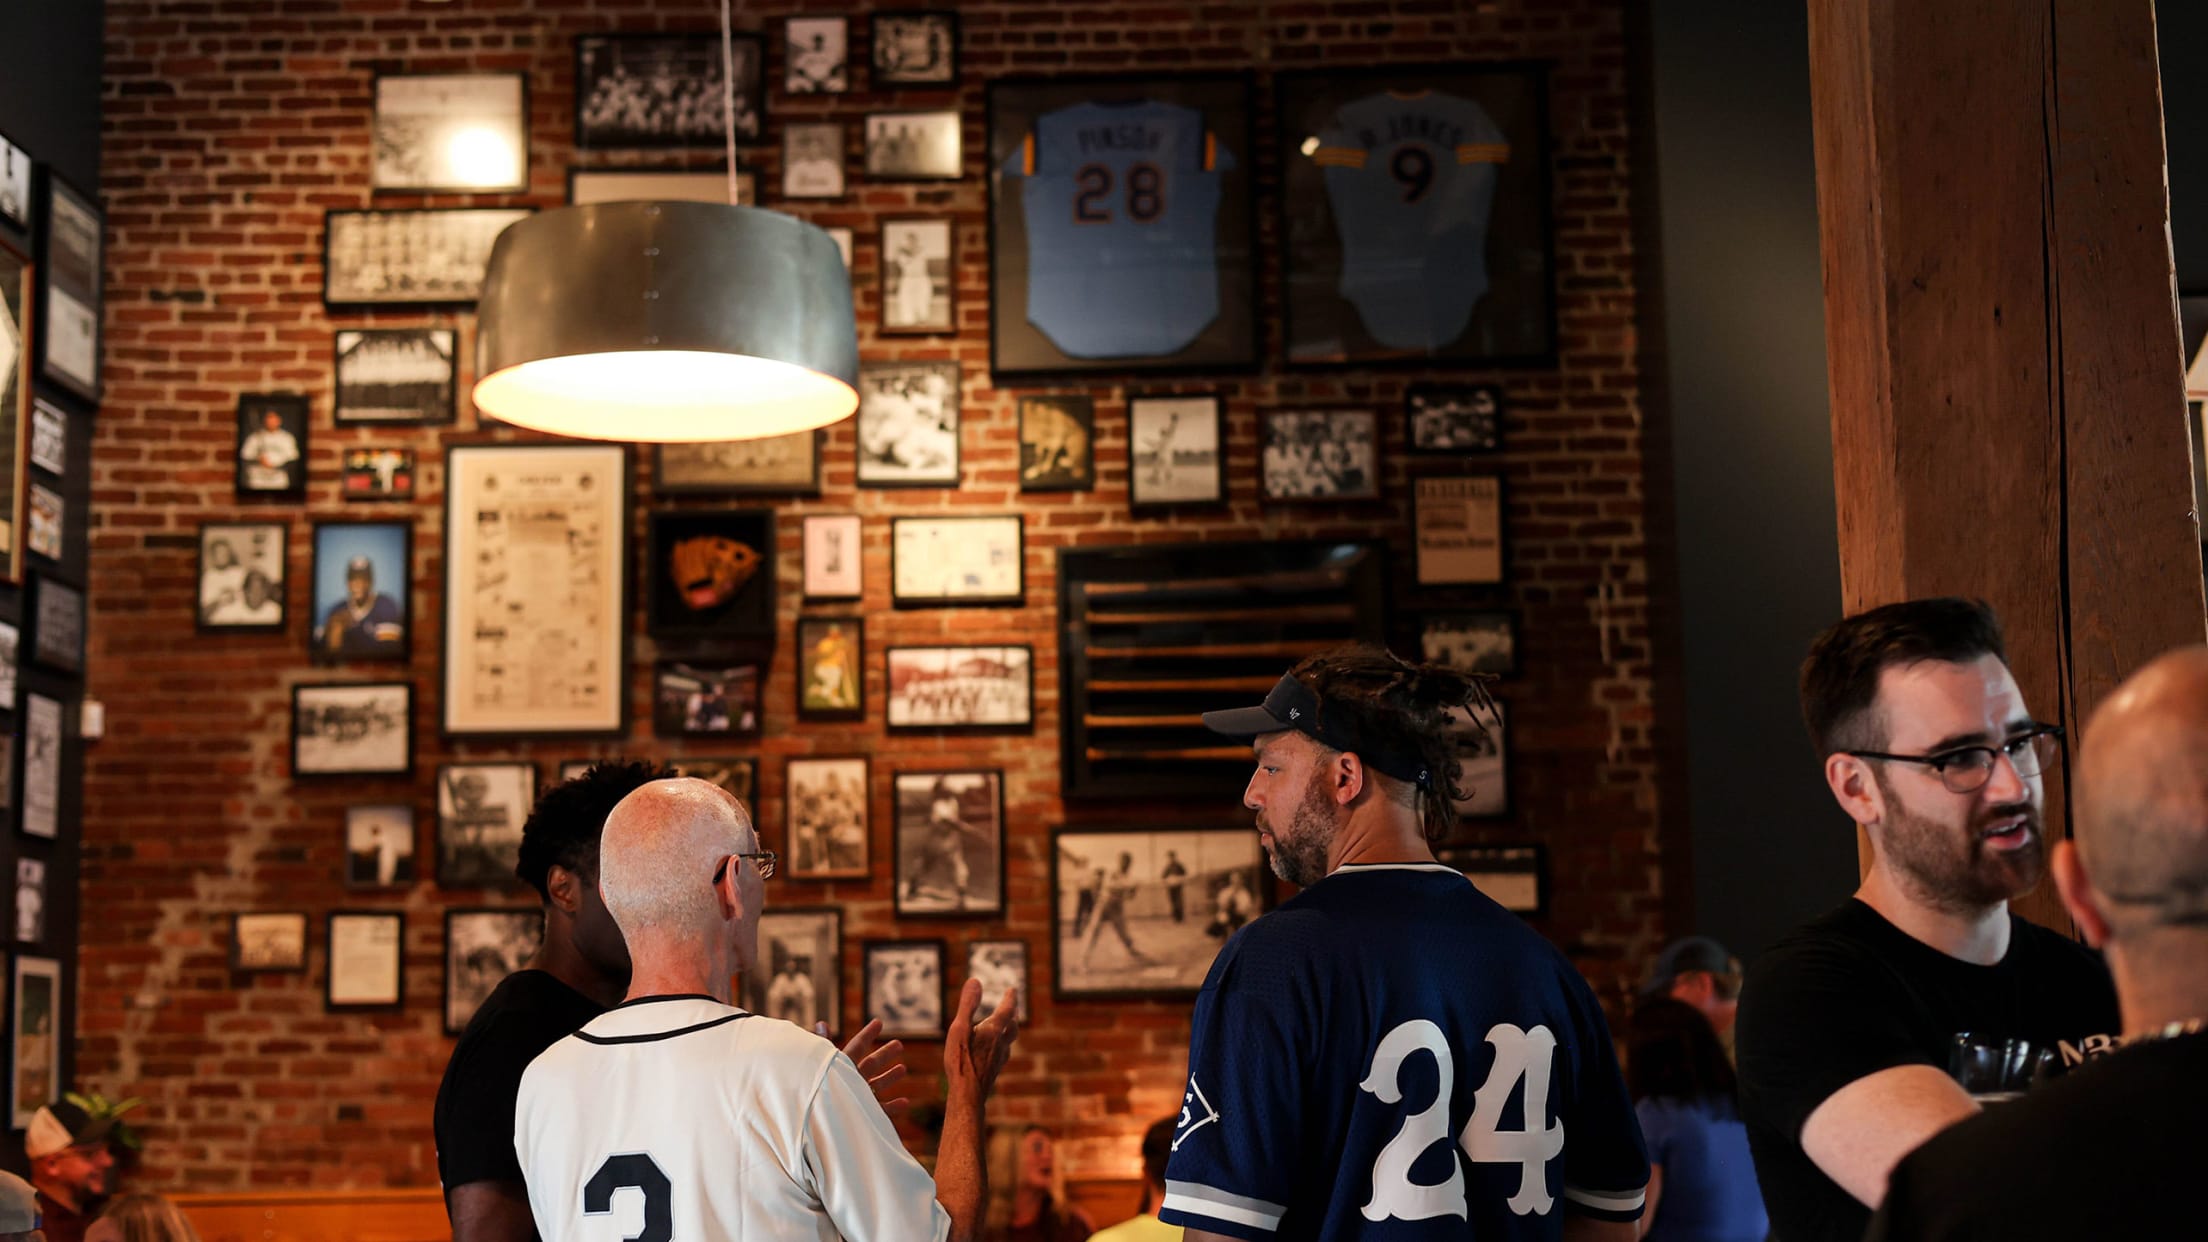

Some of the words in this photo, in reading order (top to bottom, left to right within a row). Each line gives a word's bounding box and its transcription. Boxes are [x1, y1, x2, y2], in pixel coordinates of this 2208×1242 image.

[1072, 161, 1168, 225] 28
[1390, 142, 1436, 205] 9
[1359, 1019, 1565, 1223] 24
[582, 1150, 676, 1242] 3
